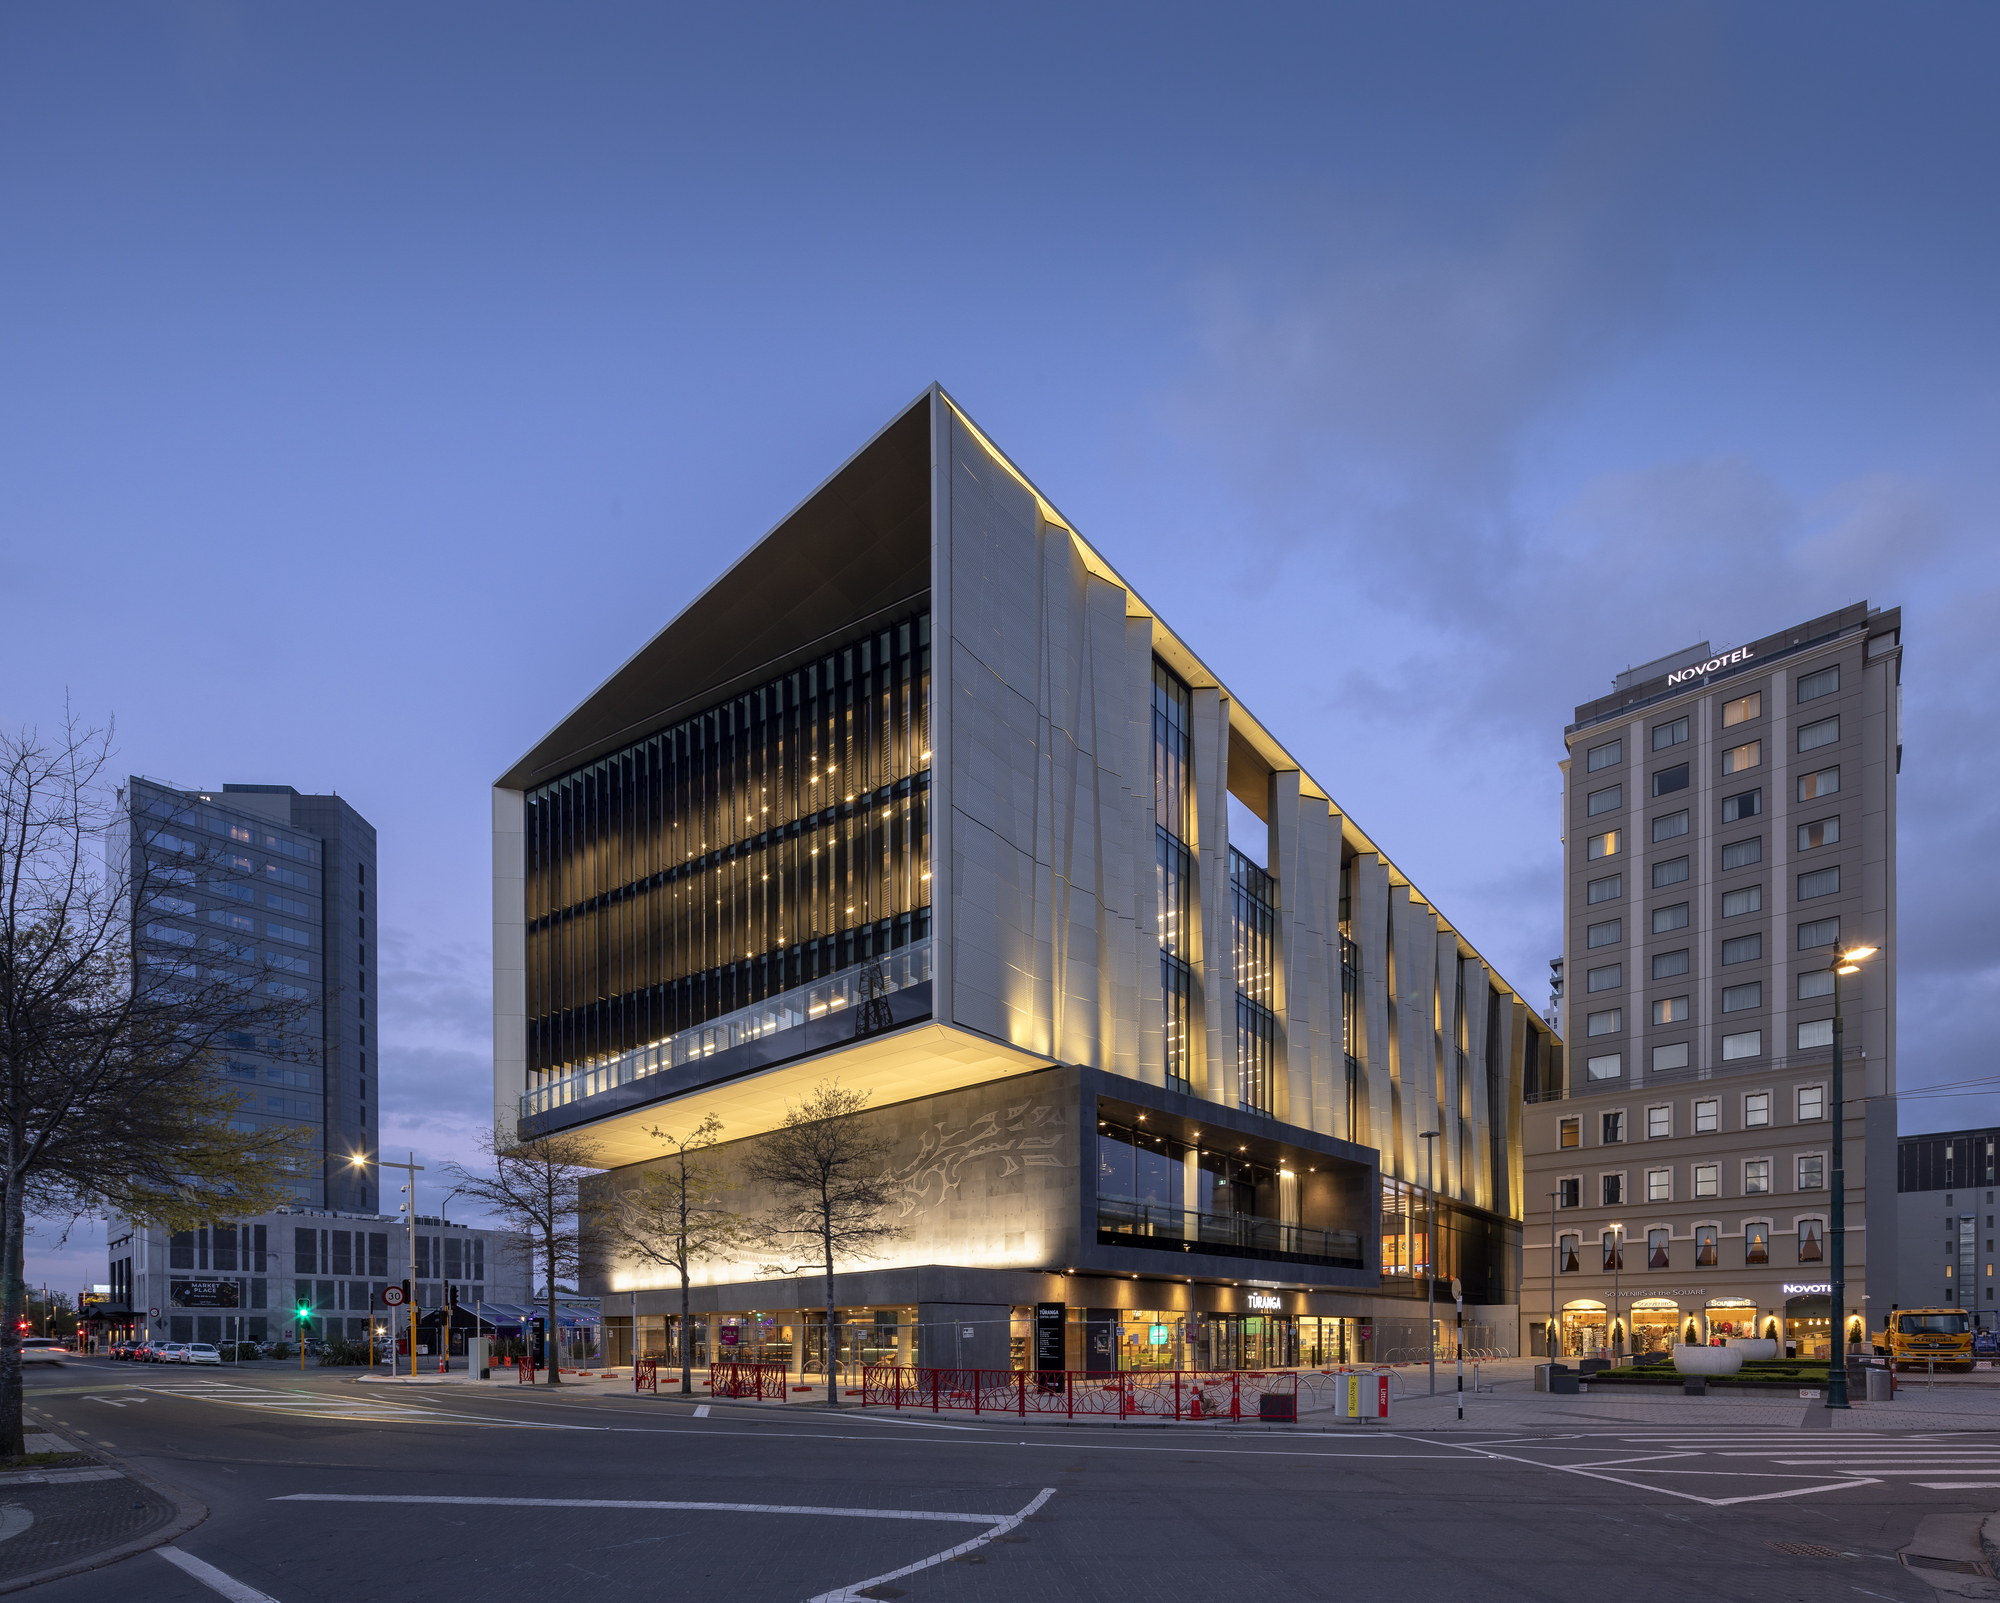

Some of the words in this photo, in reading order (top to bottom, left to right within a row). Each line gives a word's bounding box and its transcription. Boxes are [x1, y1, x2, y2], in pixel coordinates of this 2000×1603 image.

[1668, 647, 1754, 687] NOVOTEL
[1604, 1290, 1648, 1298] SOUVENIRS
[1672, 1288, 1706, 1296] SQUARE
[1783, 1284, 1831, 1293] NOVOTE
[388, 1292, 401, 1301] 30
